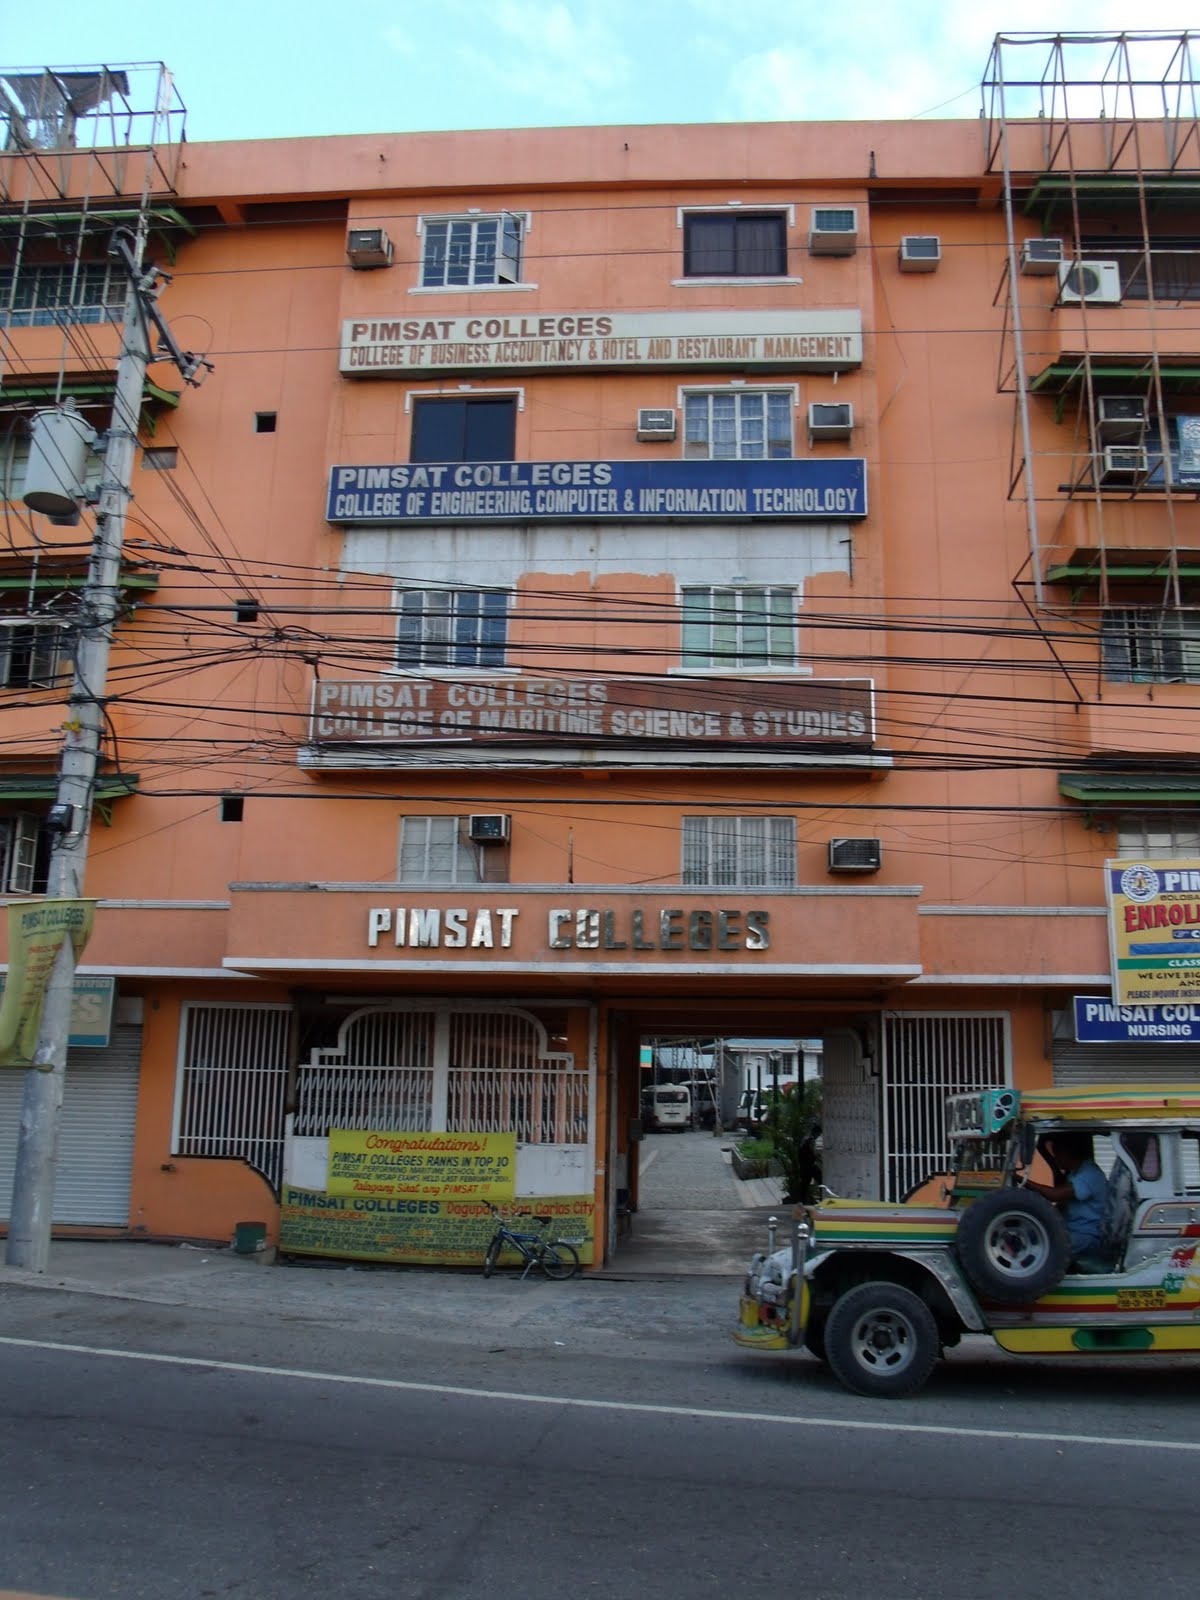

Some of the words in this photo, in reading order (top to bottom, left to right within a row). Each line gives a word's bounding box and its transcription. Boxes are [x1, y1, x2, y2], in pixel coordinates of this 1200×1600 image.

[351, 320, 456, 342] PIMSAT
[466, 317, 612, 339] COLLEGES
[350, 345, 404, 366] COLLEGE
[409, 344, 425, 365] OF
[495, 340, 583, 363] ACCOUNTANCY
[588, 340, 598, 360] &
[602, 338, 641, 360] HOTEL
[647, 338, 671, 359] AND
[678, 337, 757, 359] RESTAURANT
[763, 336, 852, 358] MANAGEMENT
[338, 467, 448, 489] PIMSAT
[454, 463, 612, 487] COLLEGES
[335, 493, 401, 516] COLLEGE
[406, 492, 425, 515] OF
[431, 490, 533, 515] ENGINEERING,
[535, 489, 618, 512] COMPUTER
[624, 489, 634, 511] &
[639, 488, 747, 512] INFORMATION
[753, 488, 857, 511] TECHNOLOGY
[320, 684, 433, 707] PIMSAT
[448, 682, 608, 707] COLLEGES
[318, 711, 433, 737] COLLEGE
[440, 711, 471, 736] OF
[479, 710, 602, 735] MARITIME
[611, 711, 721, 736] SCIENCE
[728, 711, 747, 736] &
[753, 711, 866, 737] STUDIES
[368, 908, 520, 948] PIMSAT
[548, 908, 770, 951] COLLEGES
[1127, 990, 1151, 999] PLEASE
[1086, 1003, 1157, 1022] PIMSAT
[1128, 1024, 1192, 1036] NURSING
[366, 1134, 487, 1153] Congratulations!
[332, 1152, 368, 1164] PIMSAT
[370, 1153, 424, 1166] COLLEGES
[426, 1156, 459, 1167] RANKS
[461, 1156, 472, 1167] IN
[474, 1156, 494, 1167] TOP
[496, 1156, 509, 1167] 10
[447, 1167, 475, 1175] SCHOOL
[488, 1167, 500, 1175] THE
[443, 1184, 479, 1194] PIMSAT
[288, 1190, 345, 1209] PIMSAT
[353, 1199, 440, 1214] COLLEGES
